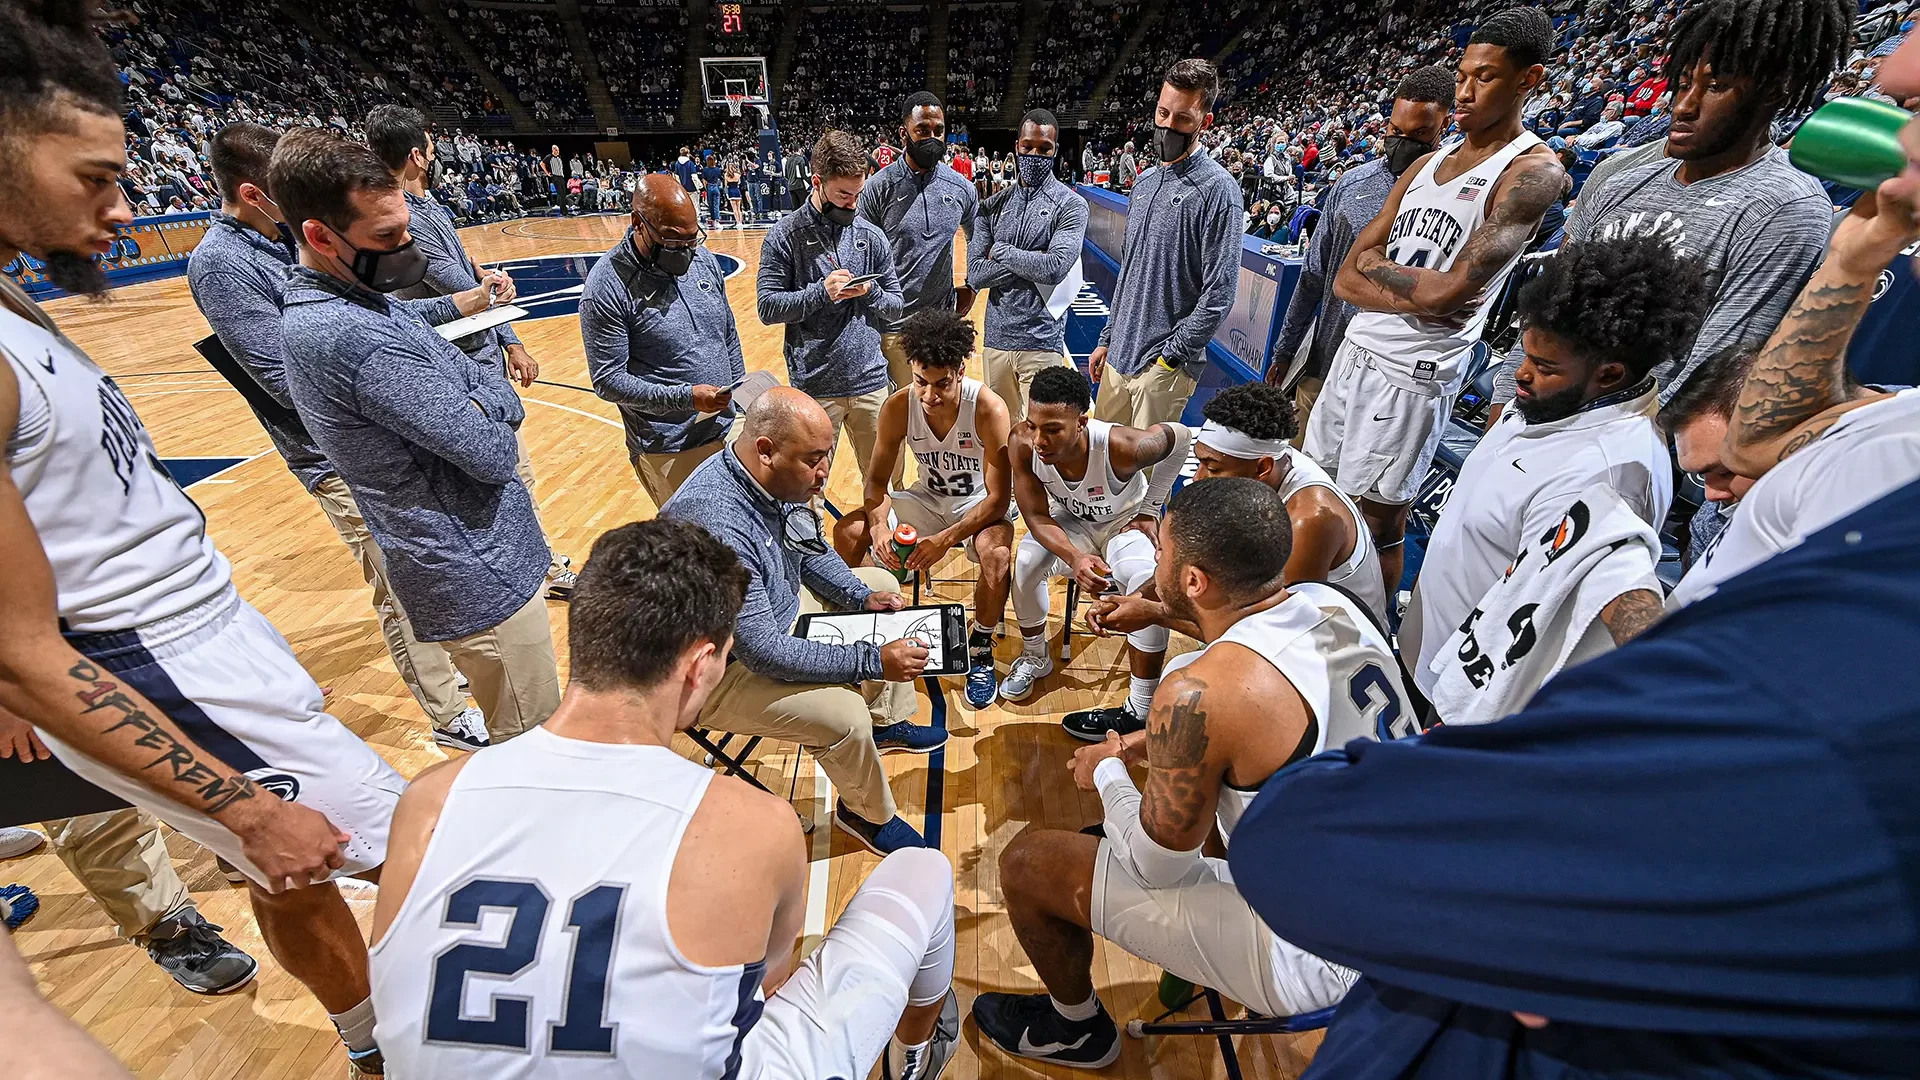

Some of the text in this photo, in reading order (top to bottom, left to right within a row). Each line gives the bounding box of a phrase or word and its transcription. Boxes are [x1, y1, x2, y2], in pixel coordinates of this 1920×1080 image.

[723, 15, 741, 32] 27
[1416, 208, 1464, 258] STATE
[942, 451, 981, 471] STATE
[928, 467, 975, 496] 23
[1072, 499, 1114, 516] STATE
[421, 874, 632, 1059] 21
